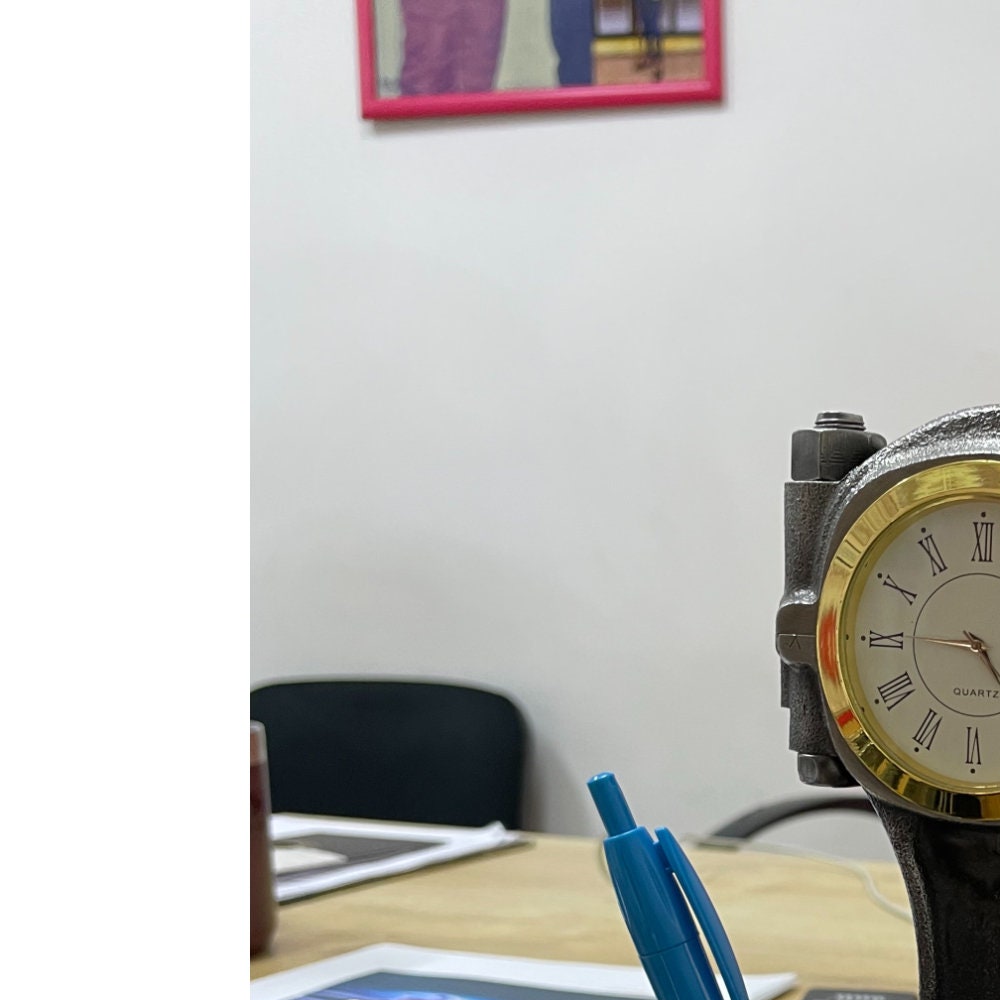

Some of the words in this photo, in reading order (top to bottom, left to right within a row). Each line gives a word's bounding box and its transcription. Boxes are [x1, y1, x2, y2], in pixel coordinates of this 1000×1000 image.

[918, 534, 948, 576] XI
[971, 522, 994, 562] XII
[883, 574, 917, 605] X
[869, 630, 904, 650] IX
[953, 687, 999, 699] QUARTZ
